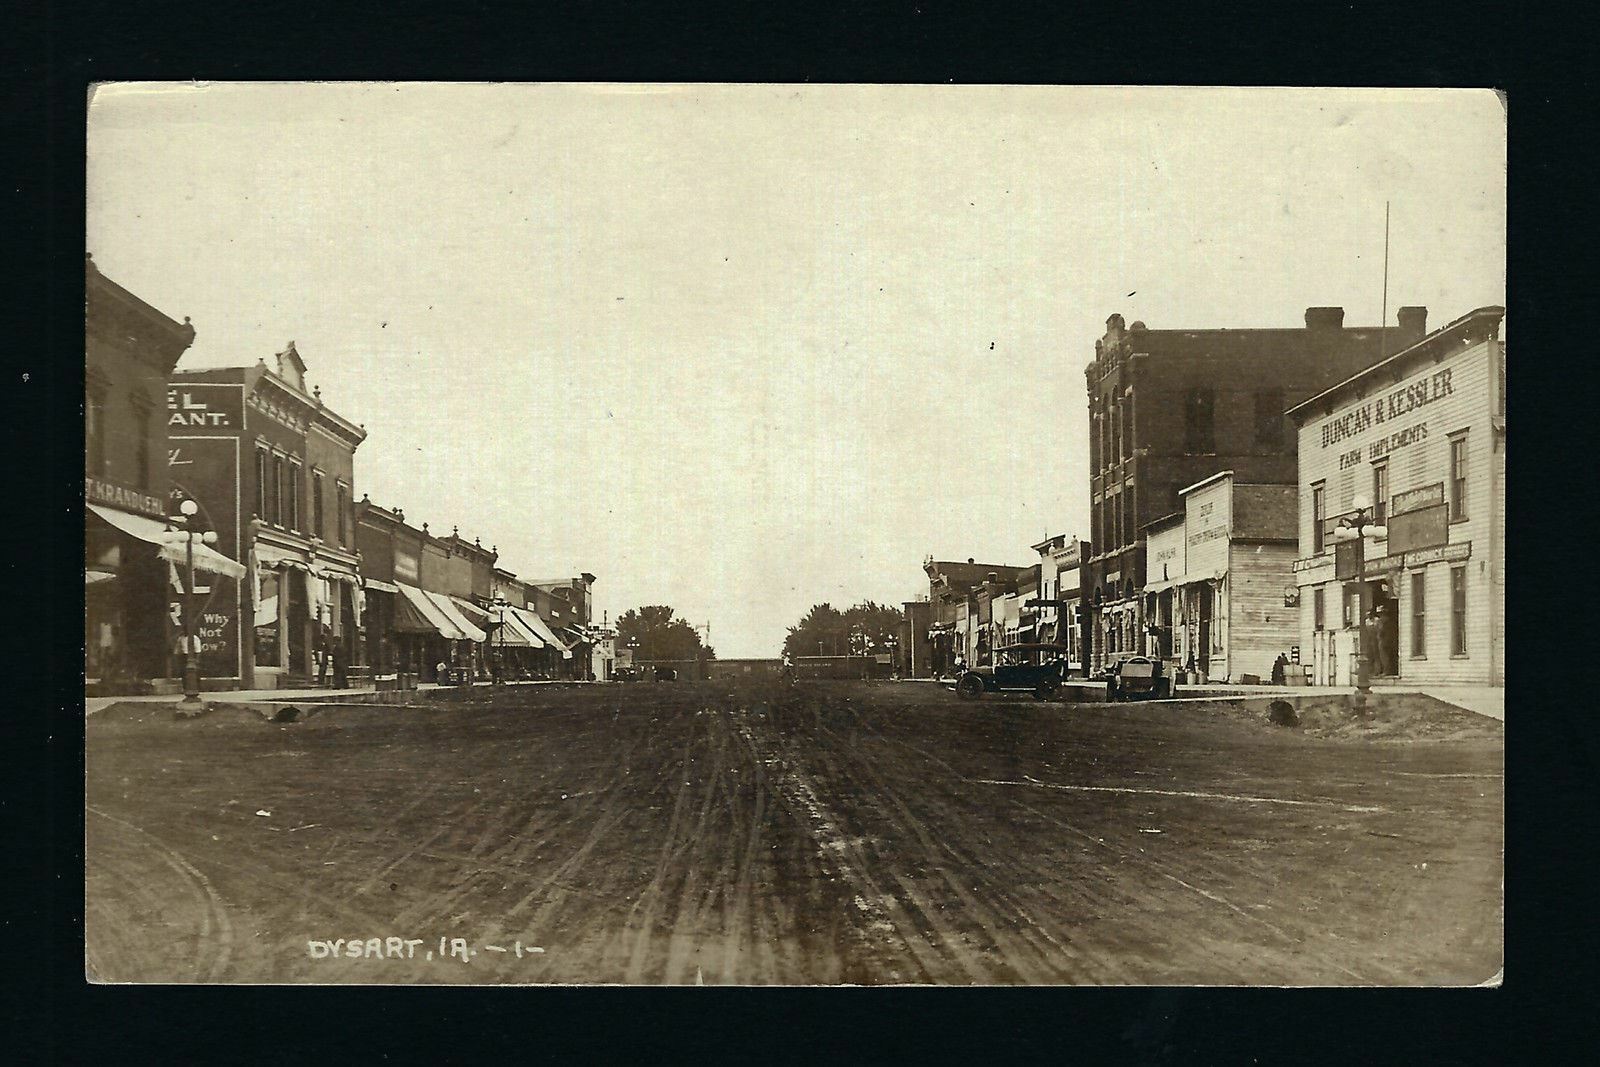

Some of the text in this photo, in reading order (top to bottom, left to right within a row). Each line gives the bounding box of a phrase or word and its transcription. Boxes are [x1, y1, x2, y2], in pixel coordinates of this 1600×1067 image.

[1321, 367, 1455, 449] DUNCAN & KESSLER
[1339, 421, 1428, 470] FARM IMPLEMENTS
[203, 613, 230, 627] Why
[199, 627, 223, 638] Not
[199, 641, 227, 652] ow?
